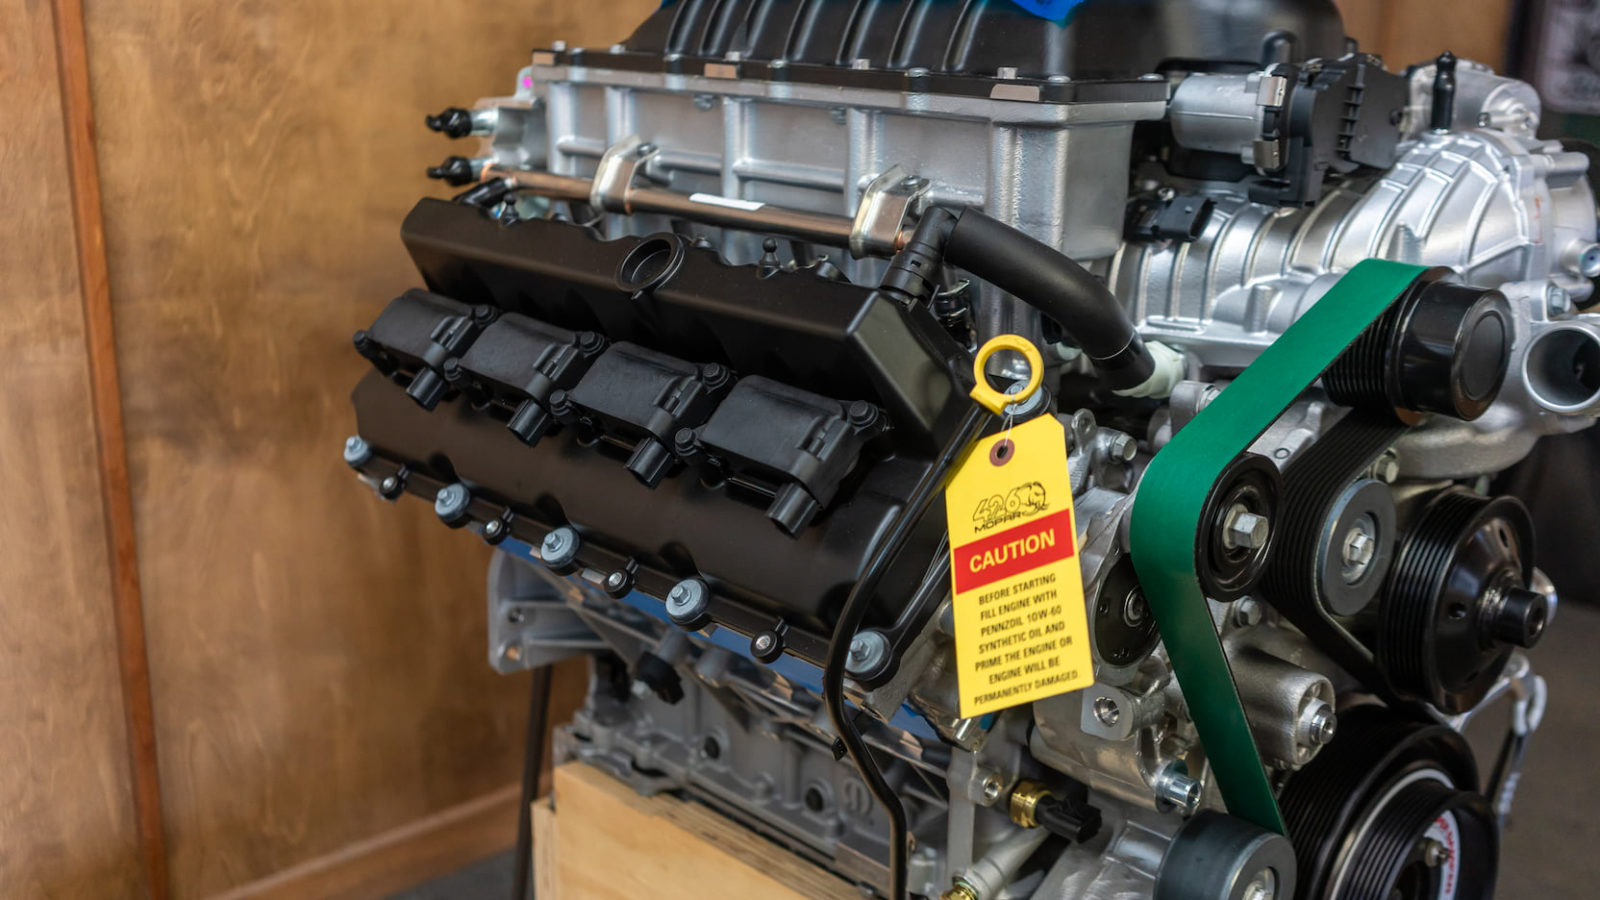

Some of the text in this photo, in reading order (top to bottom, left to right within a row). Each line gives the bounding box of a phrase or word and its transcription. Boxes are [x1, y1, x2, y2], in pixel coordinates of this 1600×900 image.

[974, 511, 1022, 533] MOPAR
[969, 528, 1056, 573] CAUTION
[978, 573, 1056, 606] BEFORE STARTING
[980, 590, 1057, 620] FILL ENGINE WITH
[978, 621, 1065, 654] SYNTHETIC OIL AND
[981, 617, 1023, 637] PENNZOIL
[975, 636, 1073, 672] PRIME THE ENGINE OR
[989, 656, 1060, 685] ENGINE WILL BE
[974, 682, 1032, 706] PERMANENTLY
